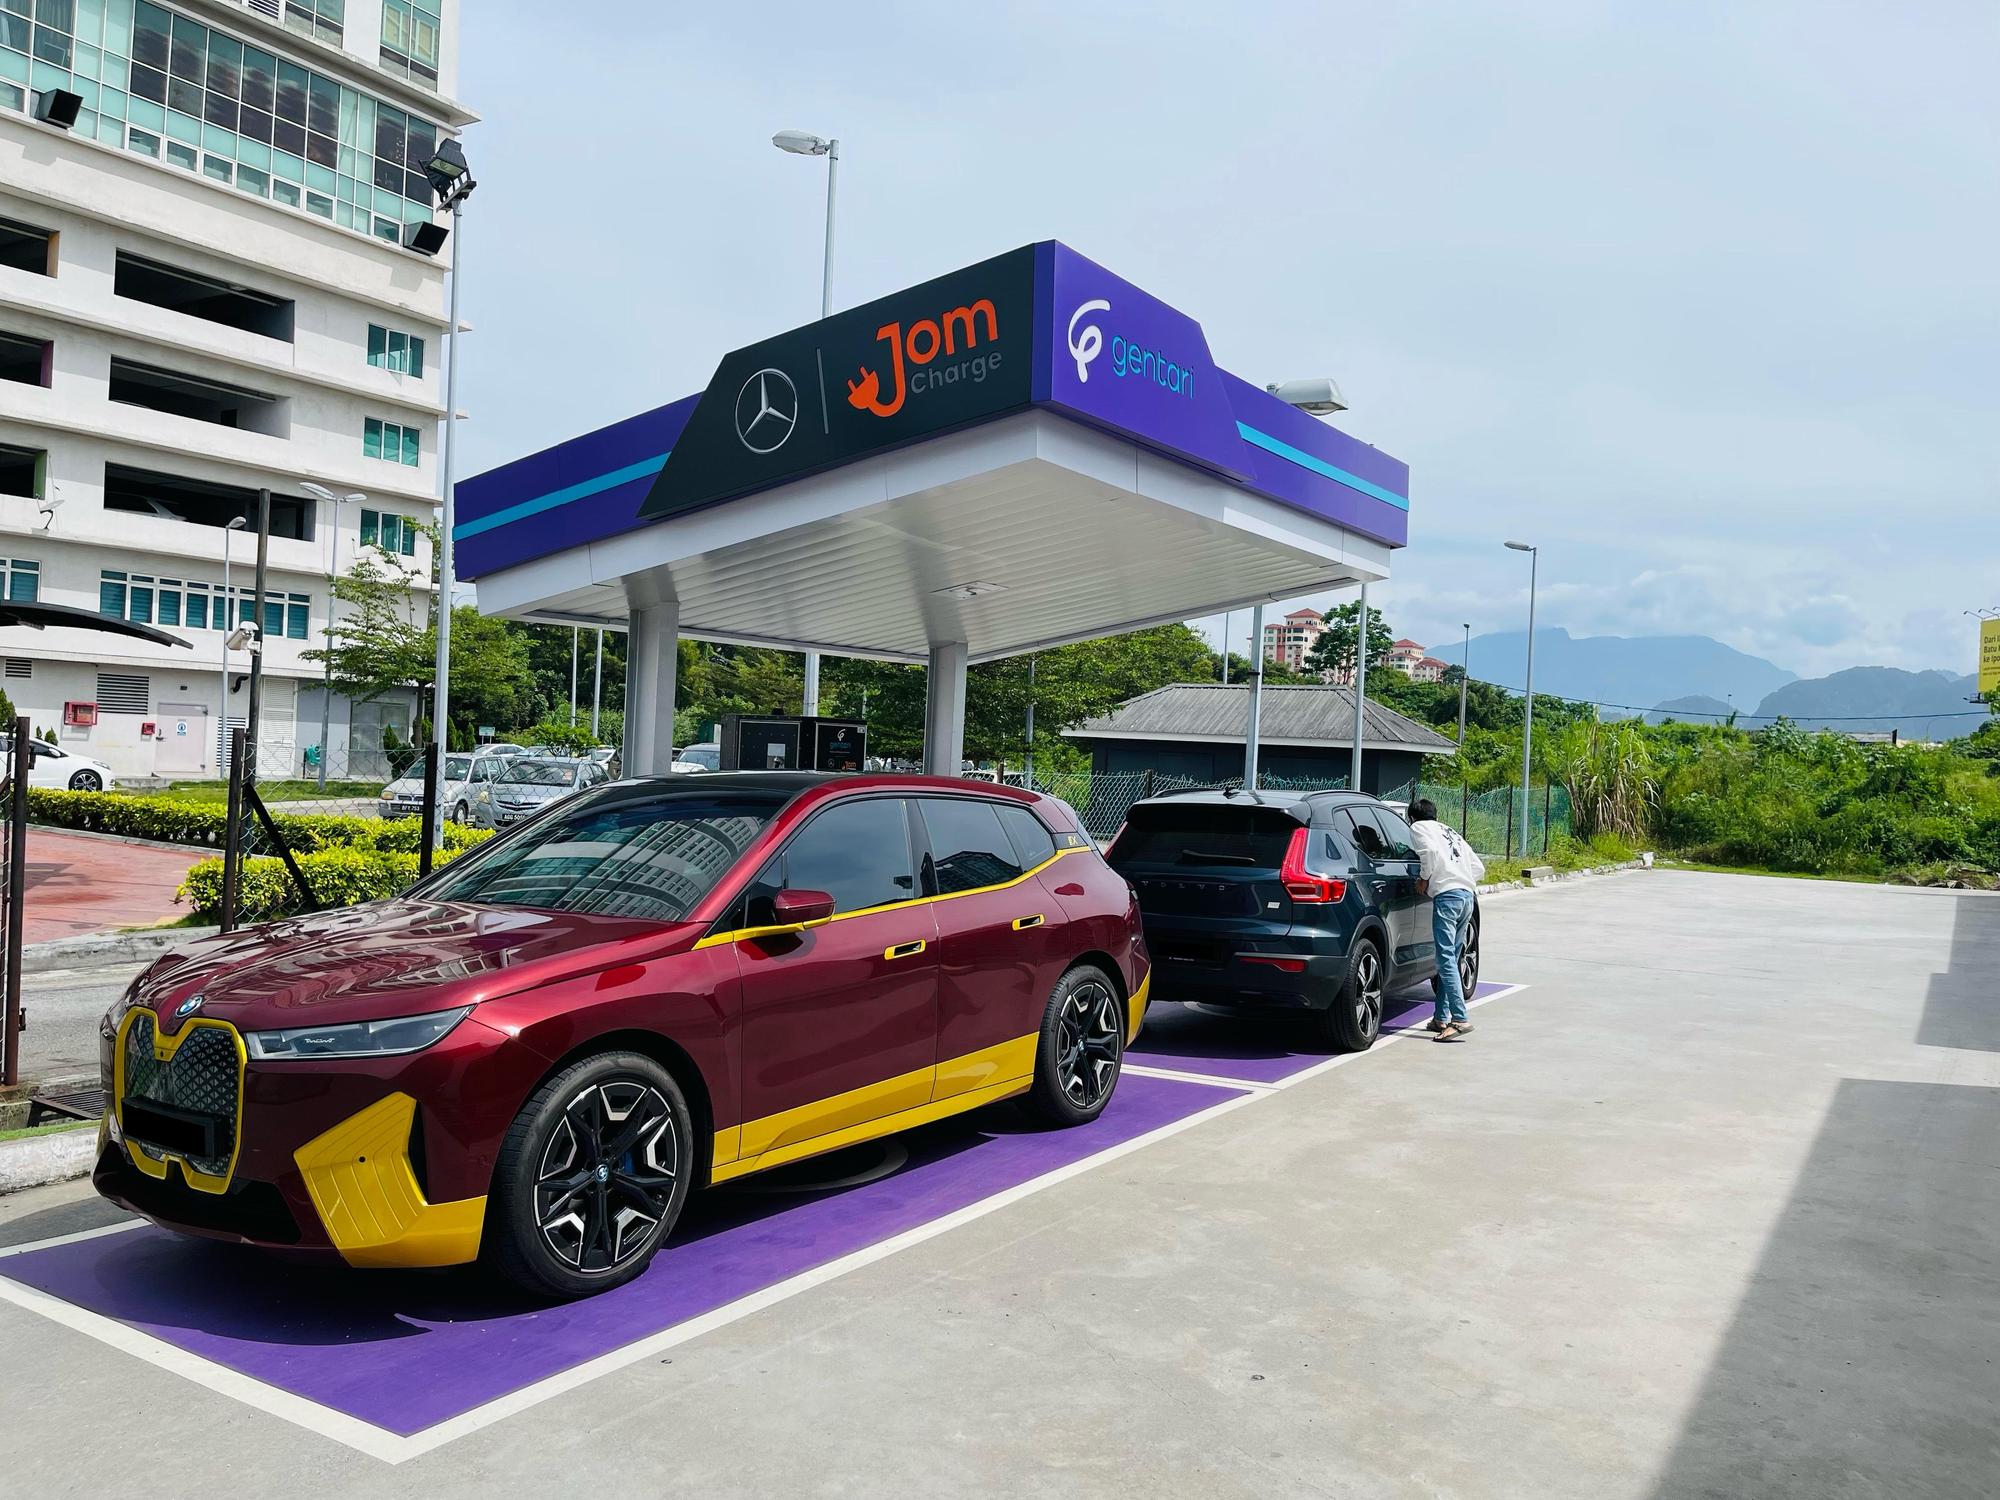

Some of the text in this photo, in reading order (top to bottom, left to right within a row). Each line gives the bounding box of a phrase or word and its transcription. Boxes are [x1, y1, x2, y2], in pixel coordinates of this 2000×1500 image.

[868, 298, 999, 417] Jom
[1111, 335, 1195, 399] gentari
[1141, 880, 1225, 891] VOLVO
